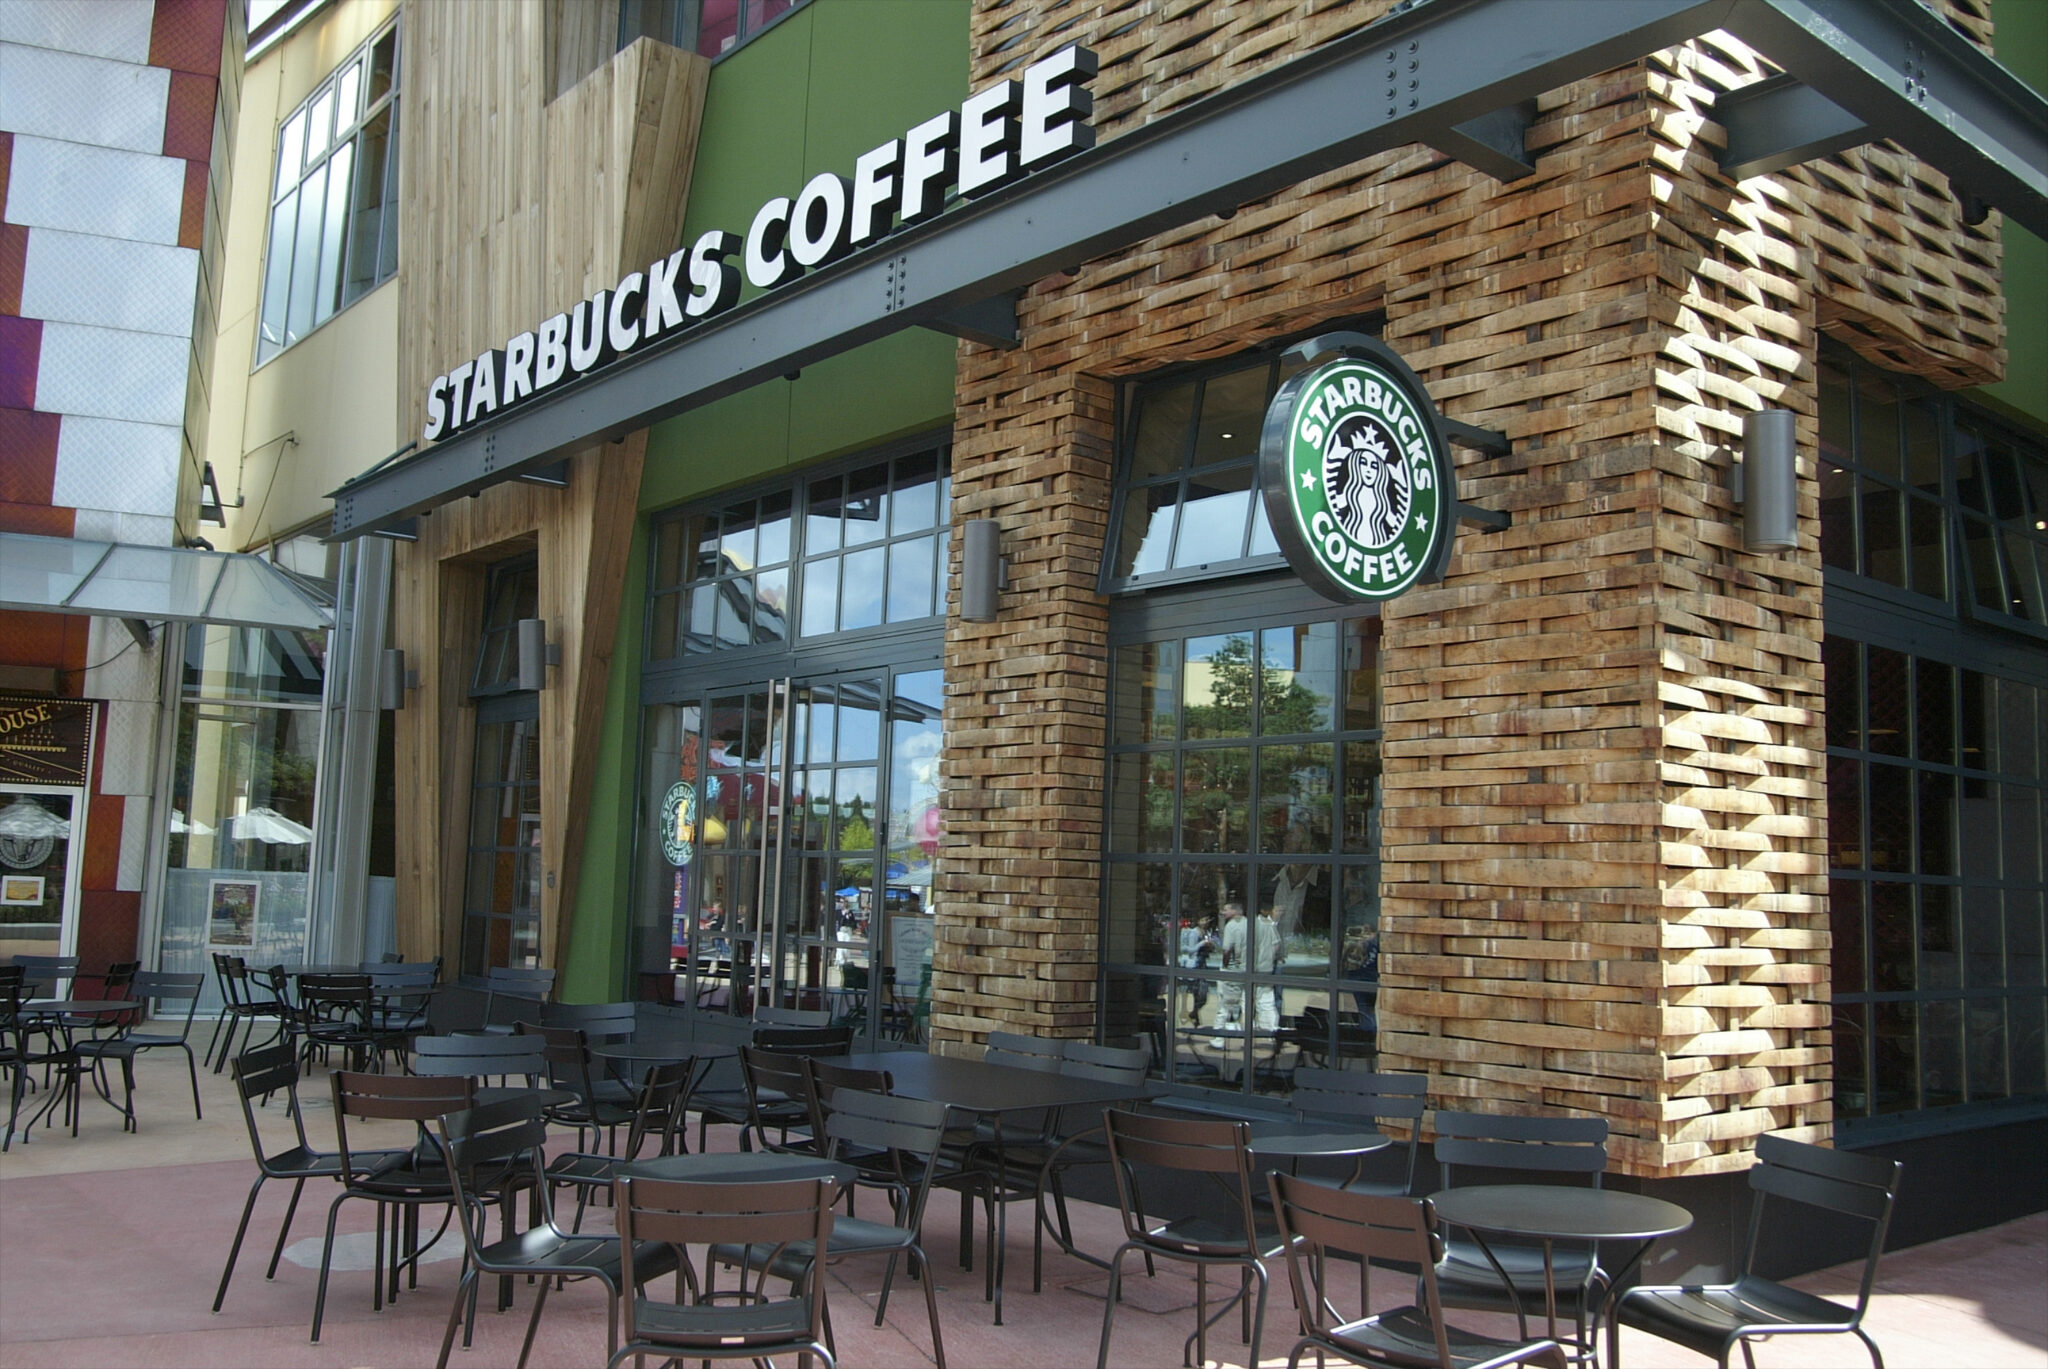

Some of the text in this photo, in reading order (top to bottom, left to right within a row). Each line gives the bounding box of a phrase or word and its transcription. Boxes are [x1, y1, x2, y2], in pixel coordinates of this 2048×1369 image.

[423, 45, 1083, 442] STARBUCKS COFFEE
[1300, 376, 1432, 491] STARBUCKS
[1311, 510, 1413, 584] COFFEE
